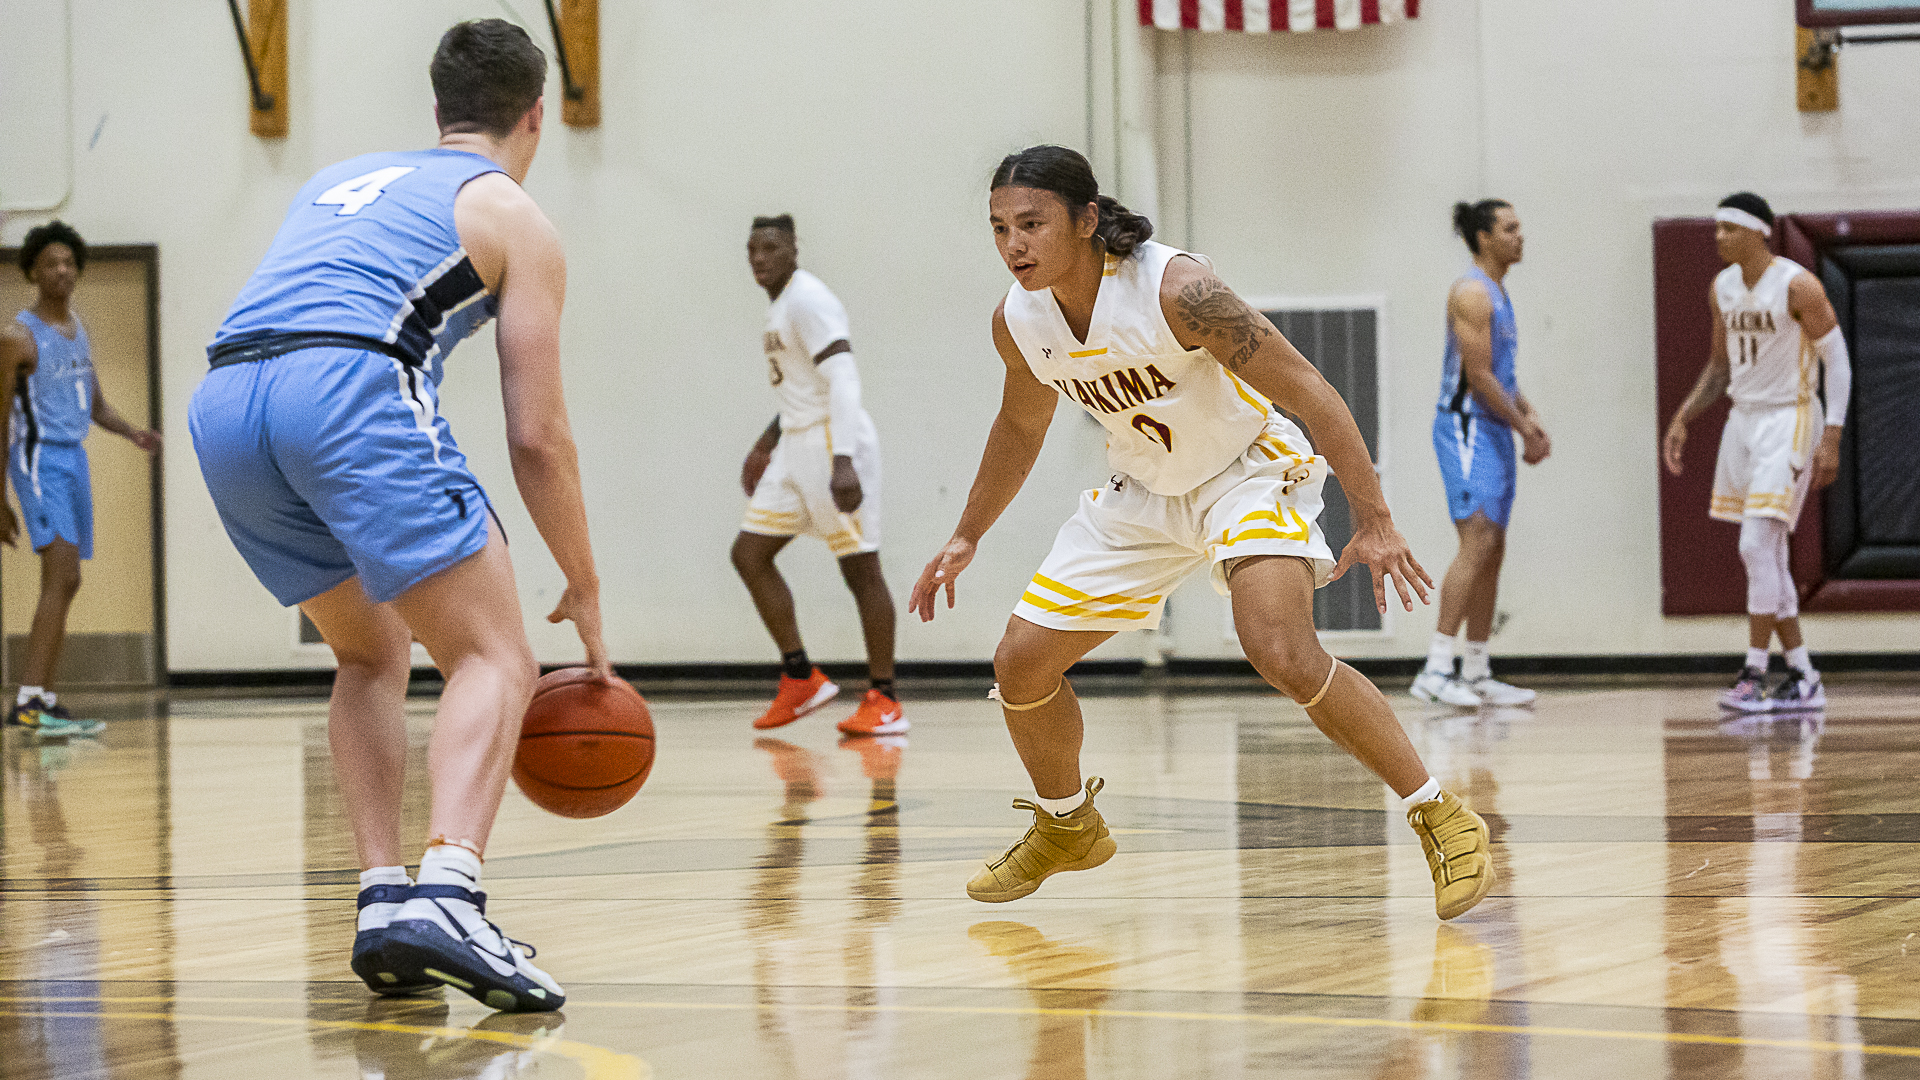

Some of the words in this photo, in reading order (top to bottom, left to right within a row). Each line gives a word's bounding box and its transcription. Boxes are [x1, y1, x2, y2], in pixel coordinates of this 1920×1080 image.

[312, 165, 420, 216] 4
[1739, 335, 1758, 366] 11
[75, 380, 87, 410] 1
[1053, 363, 1177, 415] YAKIMA
